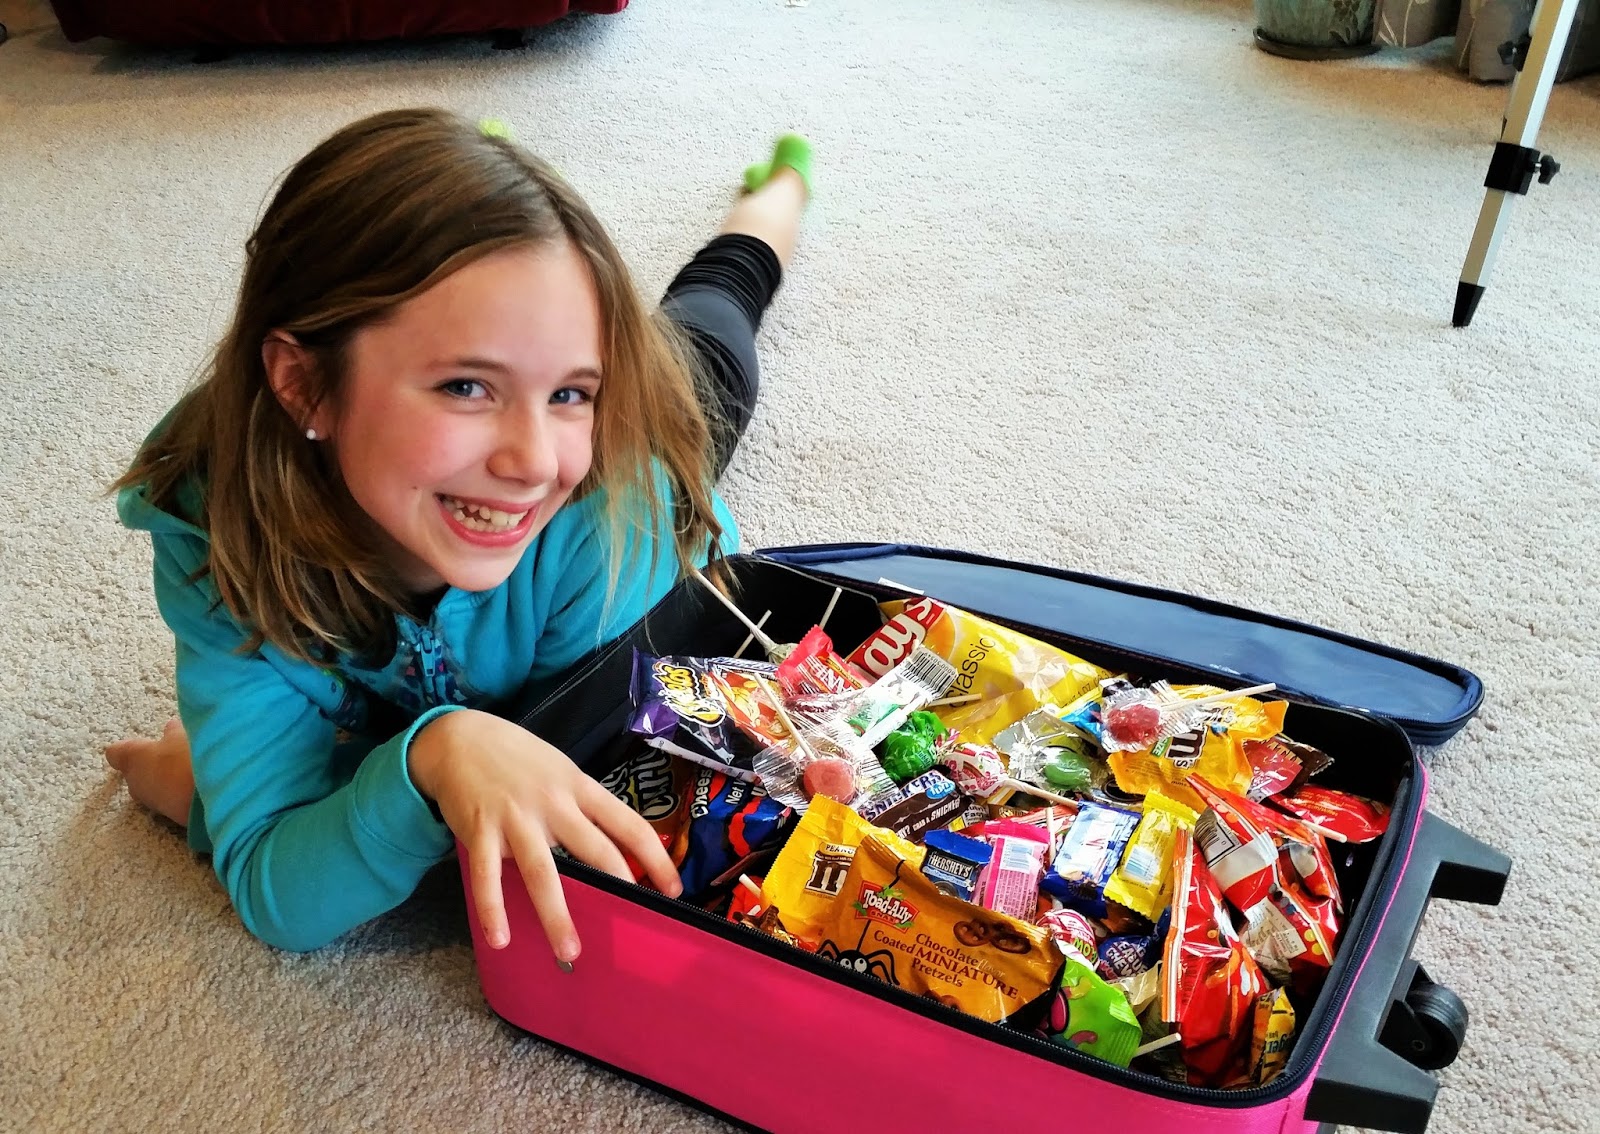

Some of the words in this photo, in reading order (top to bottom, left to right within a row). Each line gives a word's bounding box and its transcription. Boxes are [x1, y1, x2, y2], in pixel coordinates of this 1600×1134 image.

[945, 636, 996, 708] Classic
[691, 769, 712, 818] Chees
[726, 786, 744, 805] Net
[825, 843, 856, 854] PEANU
[930, 853, 970, 877] HERSHEY'S
[864, 889, 912, 924] Toad-Ally
[874, 930, 915, 954] Coated
[916, 948, 1018, 999] MINIATURE
[916, 932, 978, 966] Chocolate
[976, 959, 1005, 977] flavor
[911, 958, 962, 988] Pretzels
